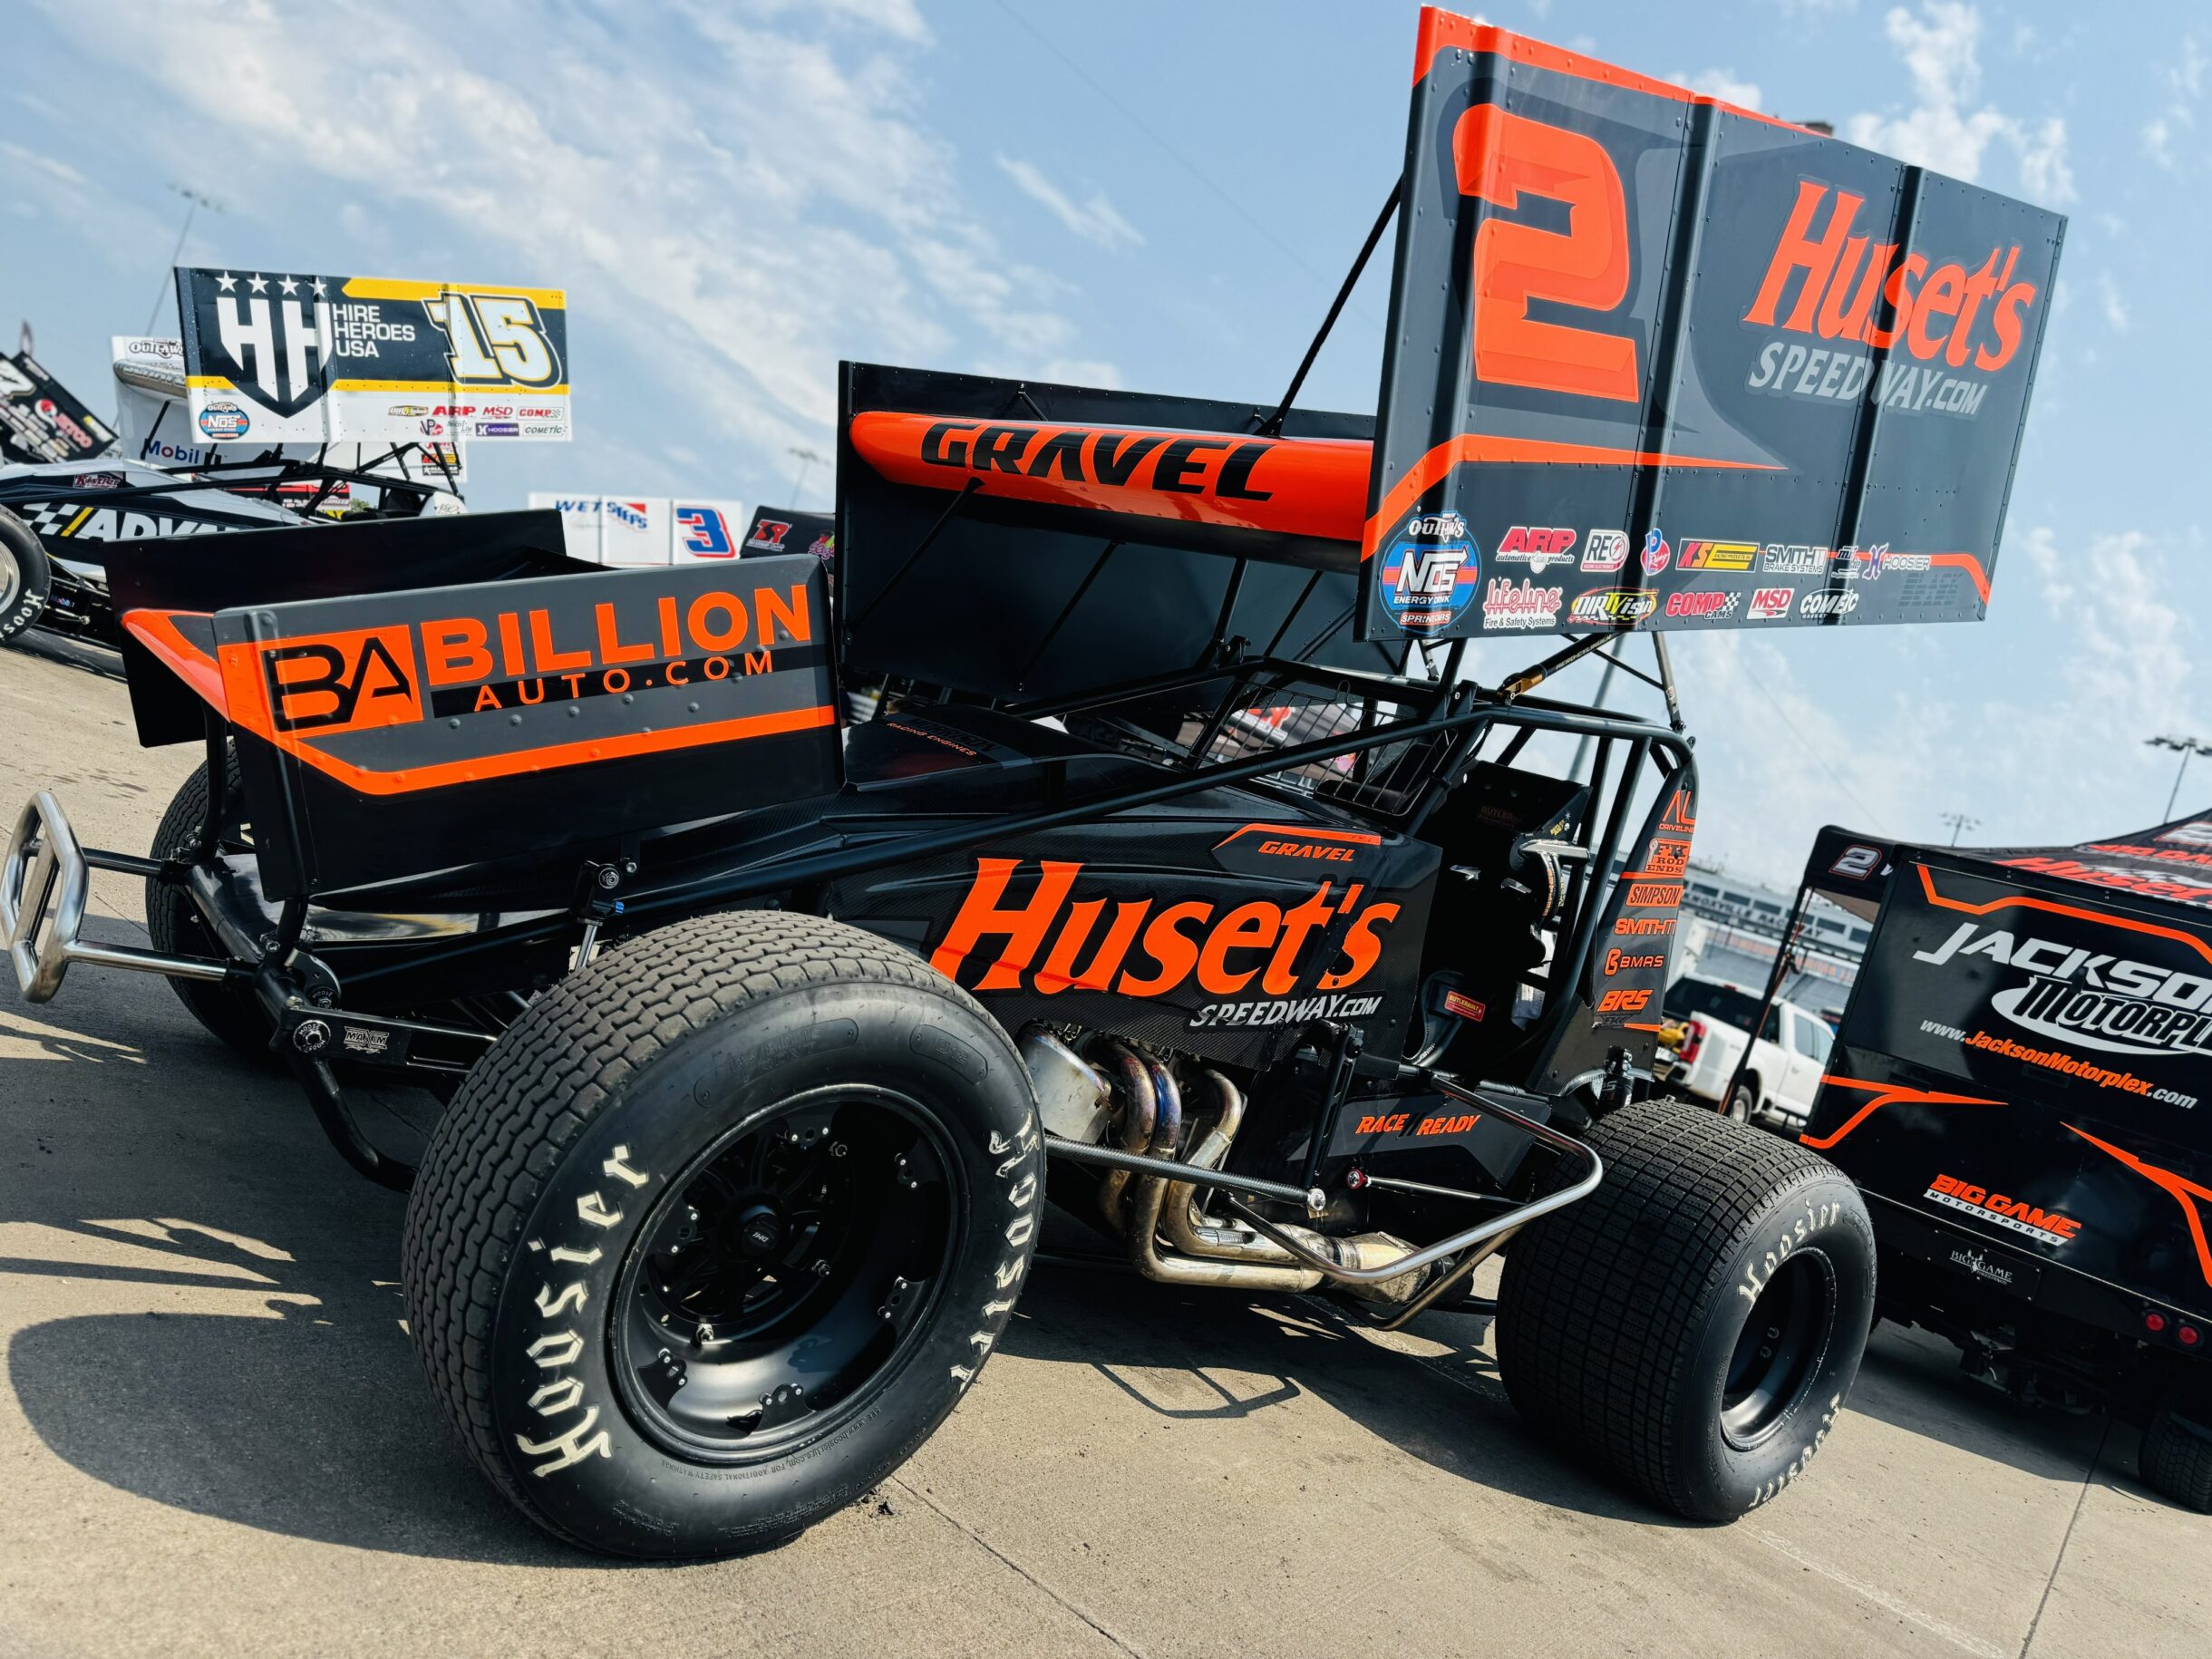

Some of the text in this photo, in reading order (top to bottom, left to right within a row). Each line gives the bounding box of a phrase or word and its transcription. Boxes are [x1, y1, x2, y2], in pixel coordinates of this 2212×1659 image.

[1452, 102, 1638, 403] 2
[1742, 180, 2036, 372] Huset's
[332, 303, 381, 323] HIRE
[334, 323, 415, 341] HEROES
[422, 292, 561, 389] 15
[335, 341, 380, 357] USA
[432, 405, 476, 416] ARP
[482, 406, 513, 416] MSD
[519, 408, 552, 417] COMP
[524, 425, 562, 434] COMETIC
[919, 422, 1276, 502] GRAVEL
[75, 474, 121, 487] Kistler
[555, 500, 602, 512] WET
[674, 505, 736, 558] 3
[1499, 528, 1577, 554] ARP
[1547, 555, 1575, 564] products
[1678, 541, 1758, 570] KSE
[1395, 547, 1469, 594] NOS
[1763, 563, 1824, 574] BRAKE SYSTEMS
[1393, 596, 1432, 605] ENERGY
[1665, 591, 1726, 617] COMP
[1751, 589, 1792, 610] MSD
[1485, 616, 1556, 627] Fire & Safety Systems
[1704, 609, 1732, 620] CAMS
[420, 584, 811, 686] BILLION
[261, 635, 412, 732] BA
[473, 650, 774, 713] AUTO.COM
[886, 722, 927, 737] RACING
[1659, 823, 1695, 833] DRIVELINE
[1257, 839, 1355, 862] GRAVEL
[1657, 857, 1684, 866] ROD
[1829, 845, 1882, 879] 2
[1646, 864, 1683, 873] ENDS
[1630, 886, 1681, 905] SIMPSON
[928, 858, 1402, 997] Huset's
[1758, 914, 1824, 937] RACAY
[1189, 994, 1382, 1028] SPEEDWAY.COM
[1596, 989, 1654, 1012] BRS
[344, 1030, 389, 1047] MAXIM
[1920, 1019, 2197, 1110] www.JacksonMotorplex.com
[1355, 1113, 1482, 1136] RACE READY
[1929, 1192, 2059, 1243] MOTORSPORTS
[1930, 1173, 2082, 1239] BIG GAME
[950, 1111, 1041, 1393] Hoosier
[1737, 1198, 1841, 1312] Hoosier
[1951, 1249, 2013, 1281] BIG GAME
[516, 1144, 649, 1477] Hoosier
[699, 1471, 723, 1481] SAFETY
[725, 1469, 769, 1481] ADDITIONAL
[771, 1462, 787, 1473] FOR
